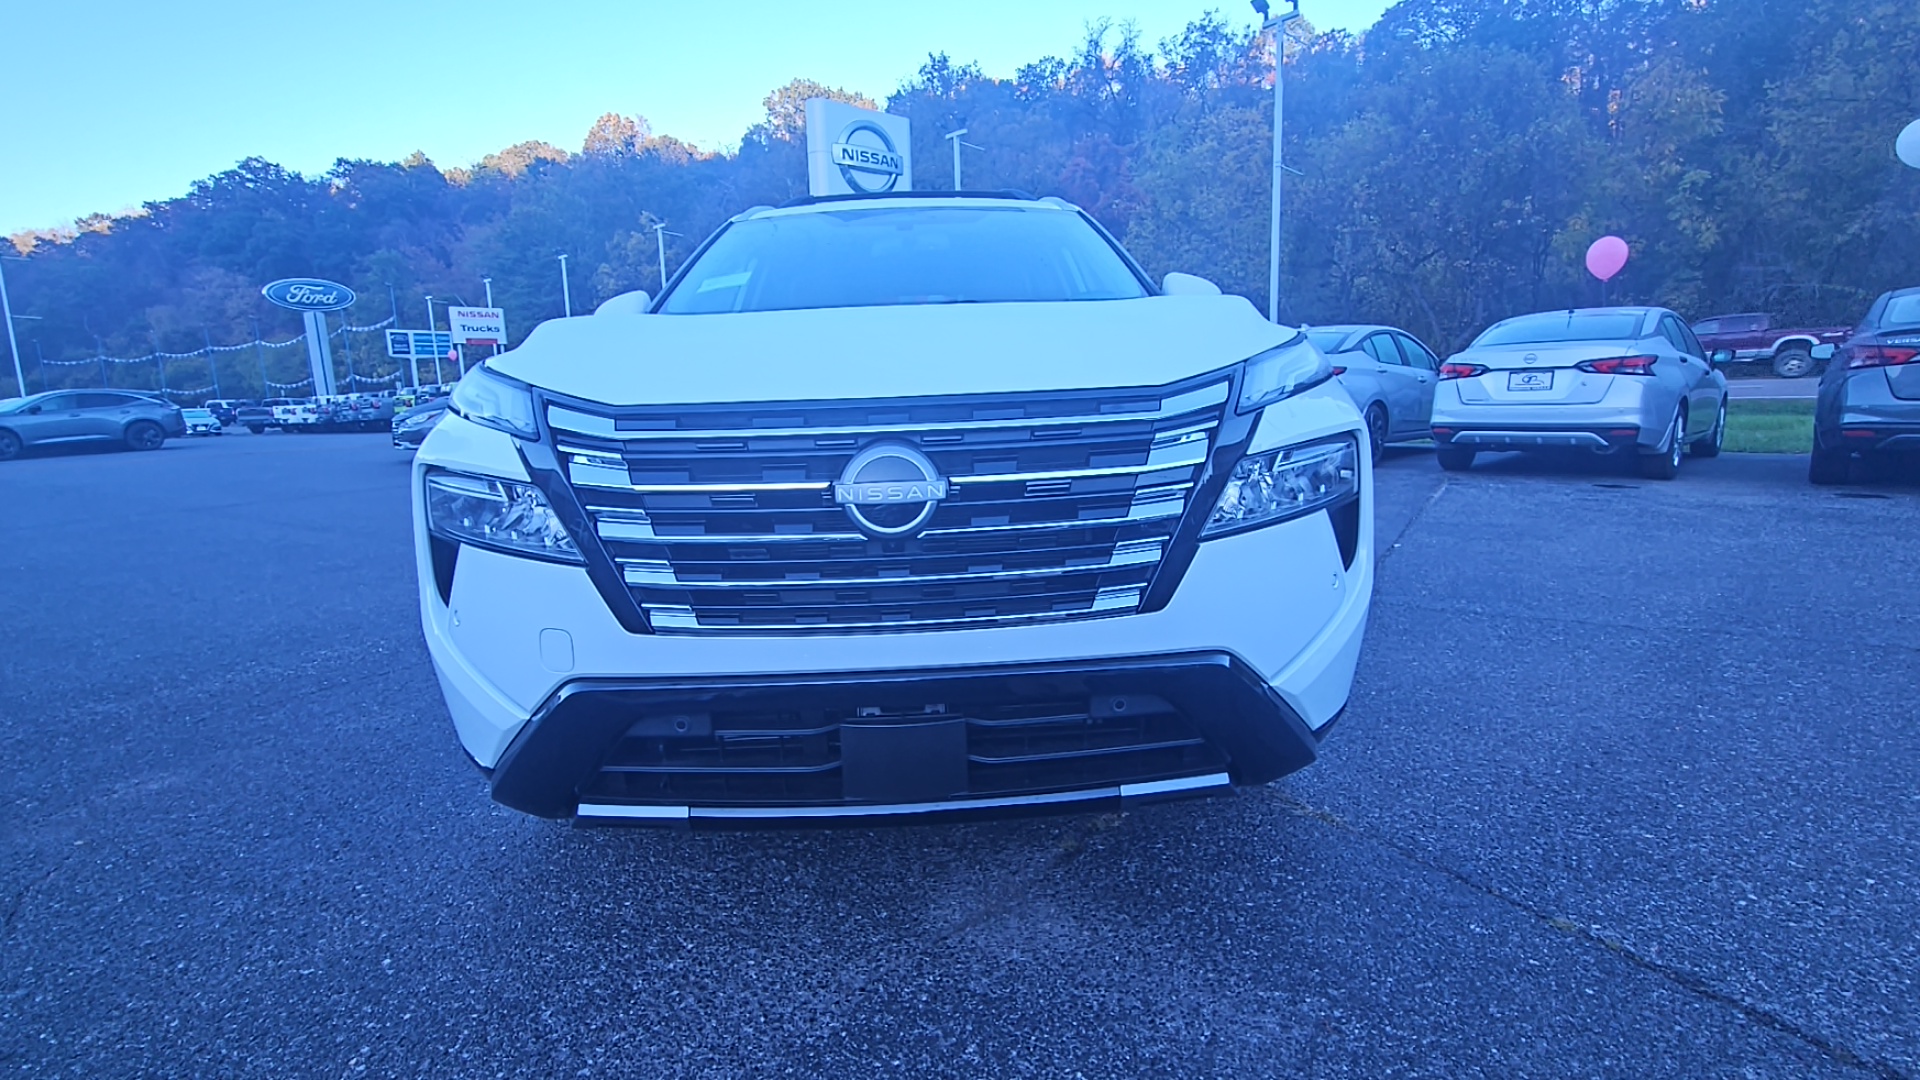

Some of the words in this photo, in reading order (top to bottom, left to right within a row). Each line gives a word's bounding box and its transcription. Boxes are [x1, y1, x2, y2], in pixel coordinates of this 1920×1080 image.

[841, 148, 899, 169] NISSAN
[286, 284, 338, 304] Ford
[457, 310, 499, 319] NISSAN
[460, 324, 500, 333] Trucks
[838, 484, 943, 502] NISSAN
